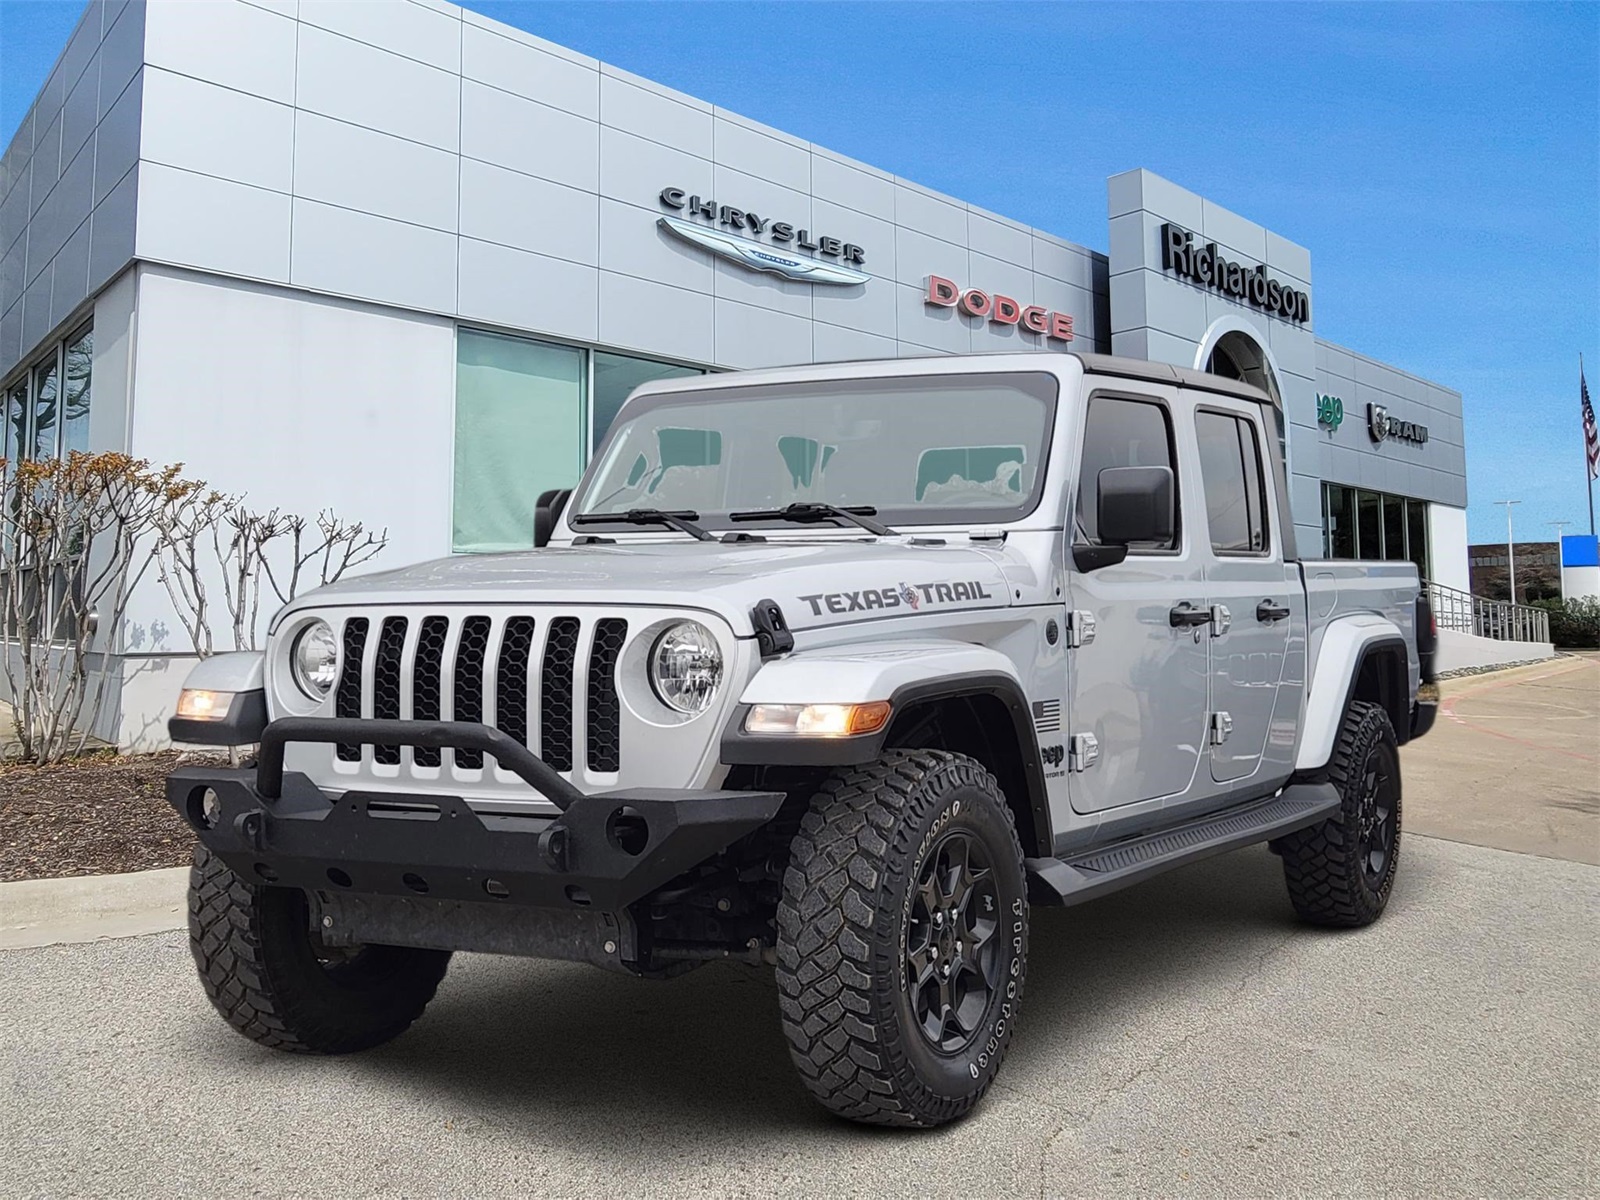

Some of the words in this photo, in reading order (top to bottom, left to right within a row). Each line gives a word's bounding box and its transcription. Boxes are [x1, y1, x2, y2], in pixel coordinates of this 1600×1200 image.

[659, 186, 866, 265] CHRYSLER
[1161, 223, 1310, 323] Richardson
[924, 274, 1074, 342] DODGE
[1387, 416, 1429, 443] RAM
[796, 587, 901, 616] TEXAS
[914, 581, 992, 604] TRAIL
